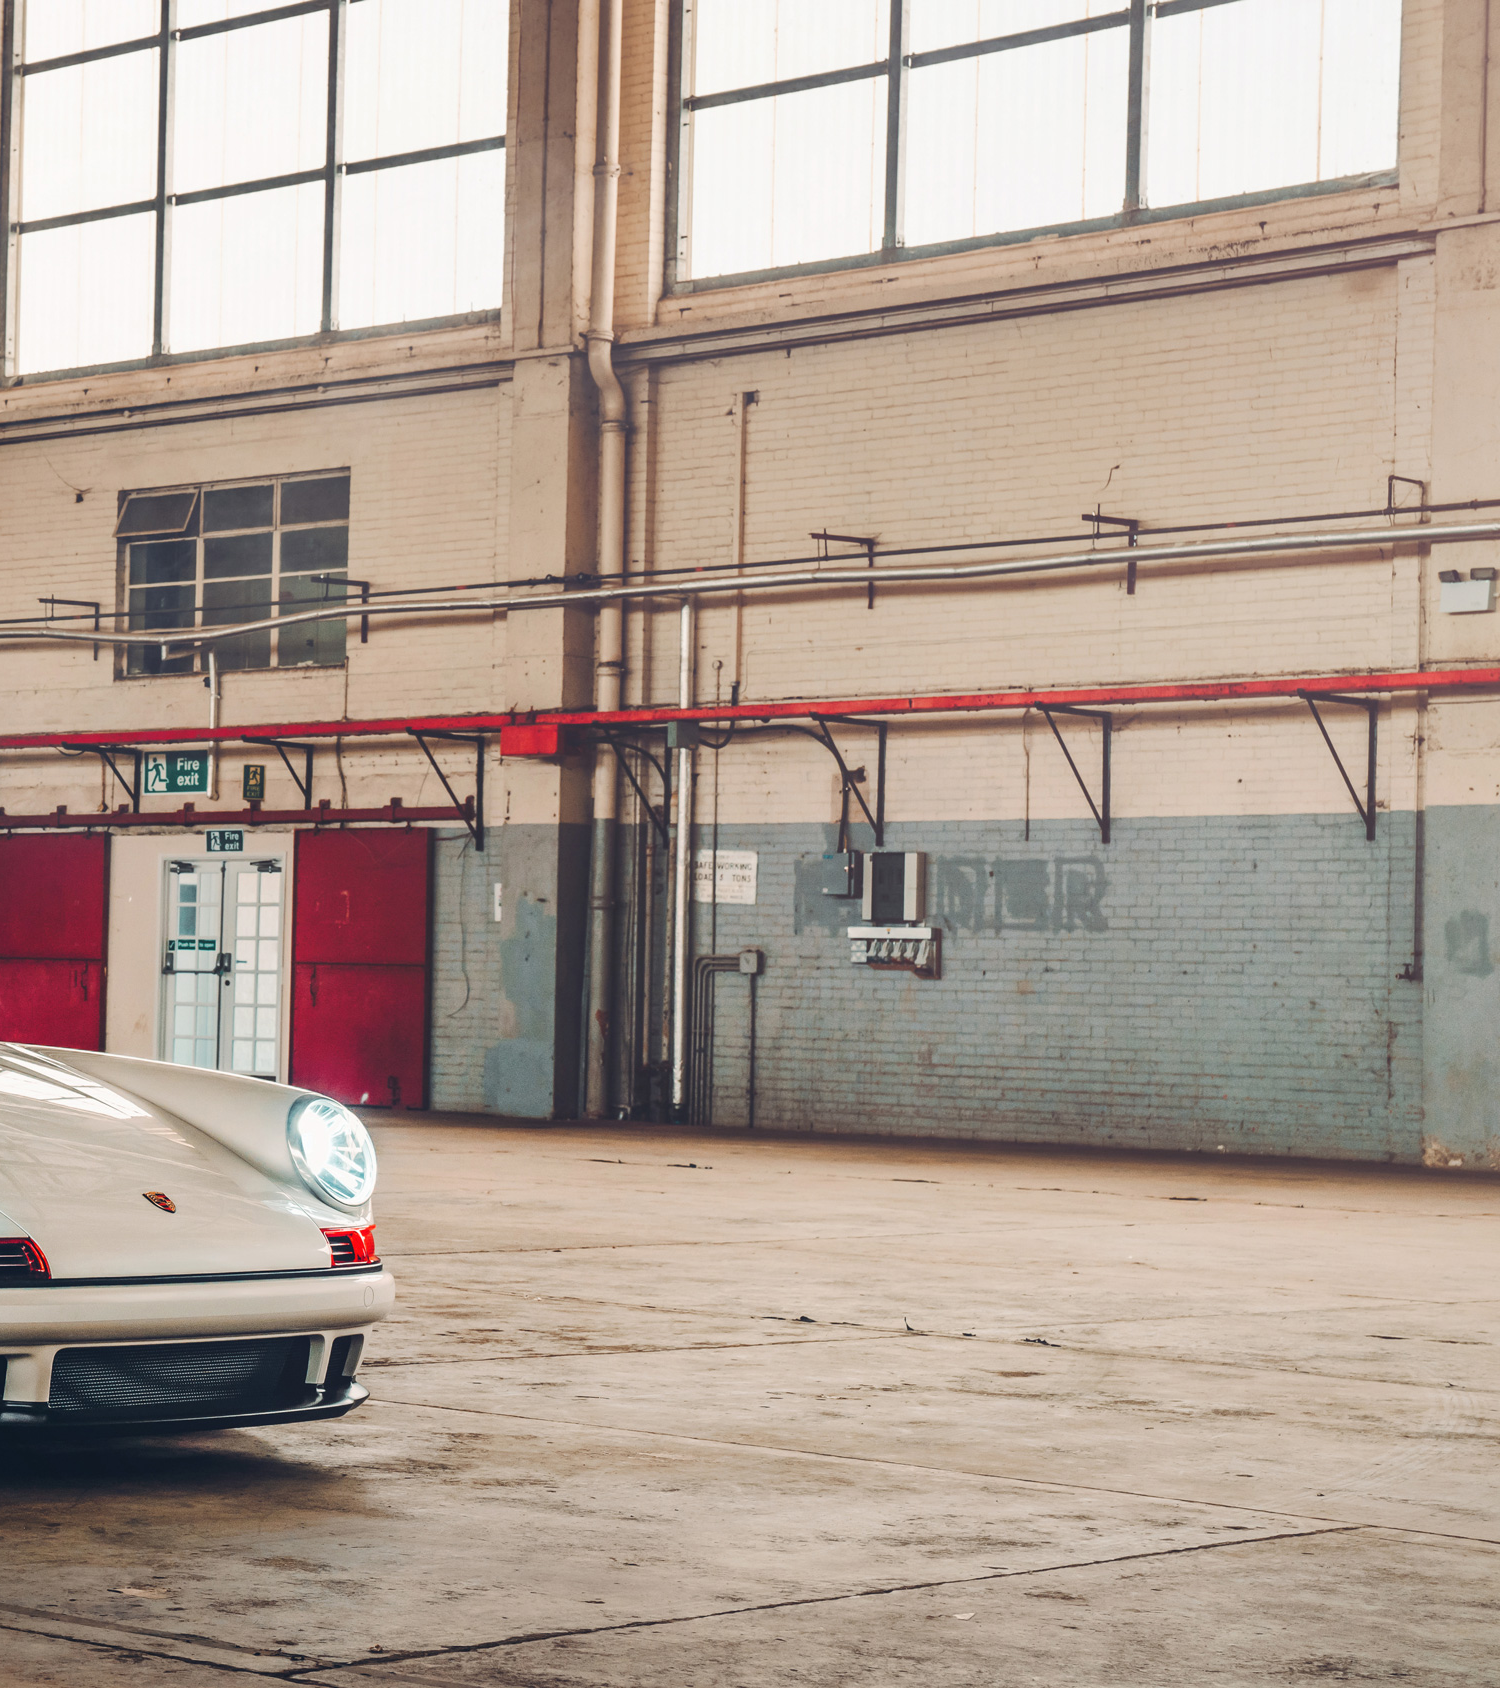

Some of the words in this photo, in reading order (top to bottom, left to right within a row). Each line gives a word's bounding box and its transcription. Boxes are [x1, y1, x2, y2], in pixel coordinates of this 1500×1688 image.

[177, 758, 200, 770] Fire
[177, 772, 199, 786] exit
[225, 832, 239, 840] Fire
[225, 842, 239, 850] exit
[716, 862, 752, 871] WORKING
[732, 874, 751, 882] TONS
